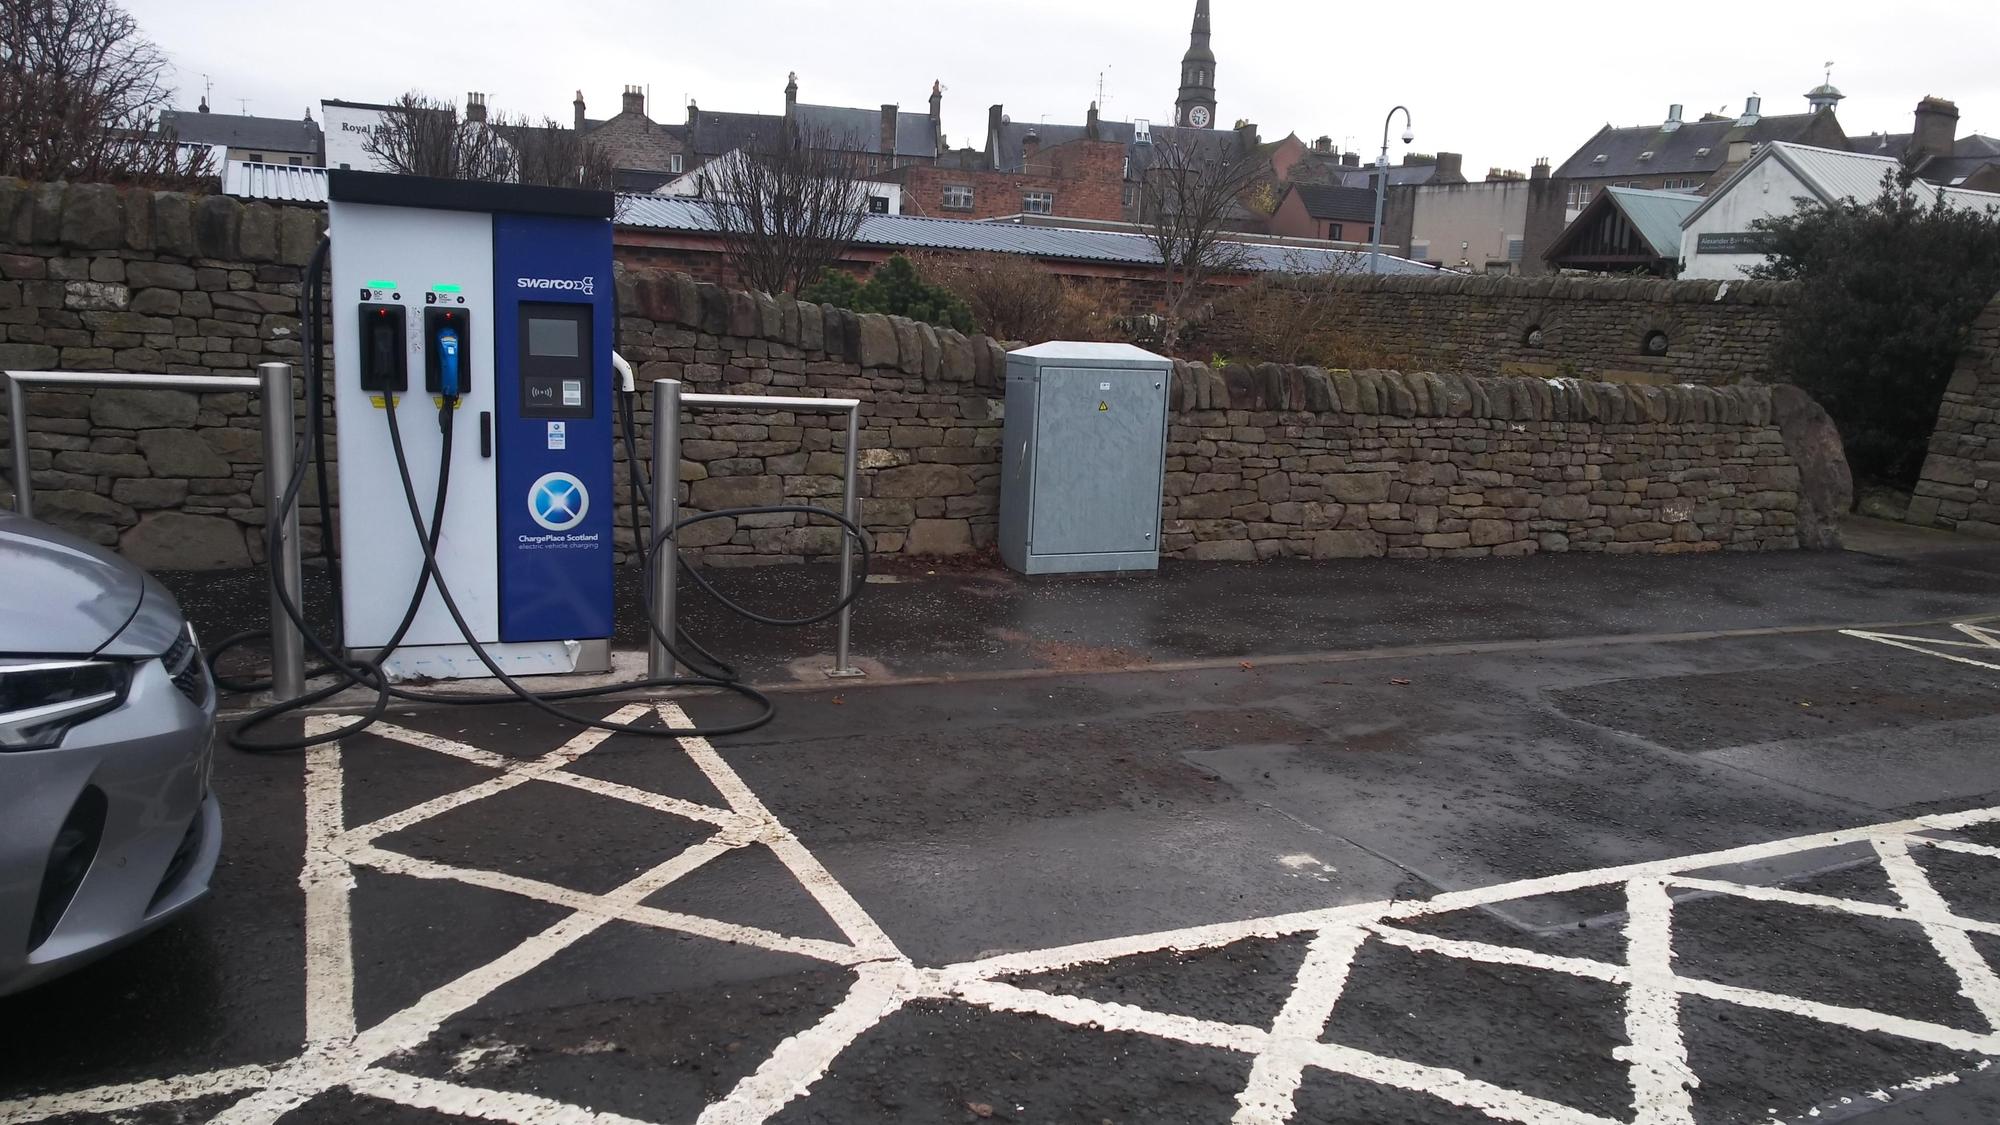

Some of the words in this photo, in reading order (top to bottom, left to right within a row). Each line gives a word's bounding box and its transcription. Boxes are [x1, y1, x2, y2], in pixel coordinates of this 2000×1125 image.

[342, 122, 370, 134] Royal
[517, 278, 573, 289] swarco
[518, 534, 565, 543] ChargePlace
[566, 533, 599, 541] Scotland
[569, 541, 599, 549] charging
